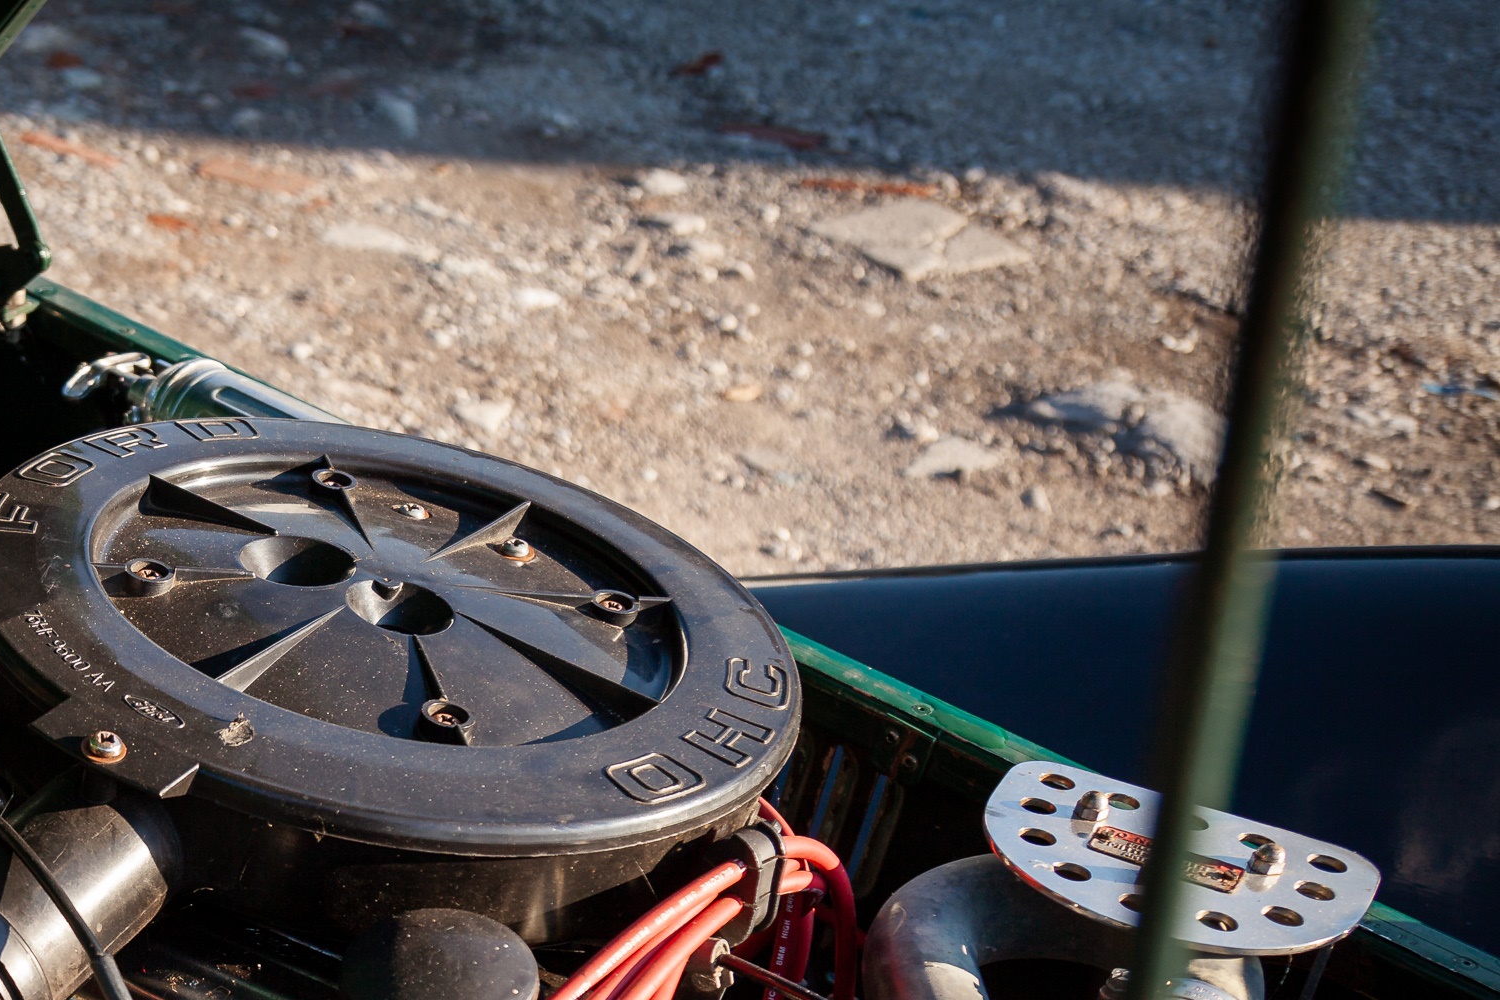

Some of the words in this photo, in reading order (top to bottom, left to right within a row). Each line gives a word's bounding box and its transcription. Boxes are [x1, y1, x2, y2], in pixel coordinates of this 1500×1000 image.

[46, 639, 91, 672] 9600
[84, 672, 116, 692] AA
[605, 656, 792, 806] OHC
[699, 866, 735, 893] SILICONE
[654, 905, 676, 926] HIGH
[780, 918, 792, 940] HIGH
[595, 926, 650, 978] PERFORMANCE
